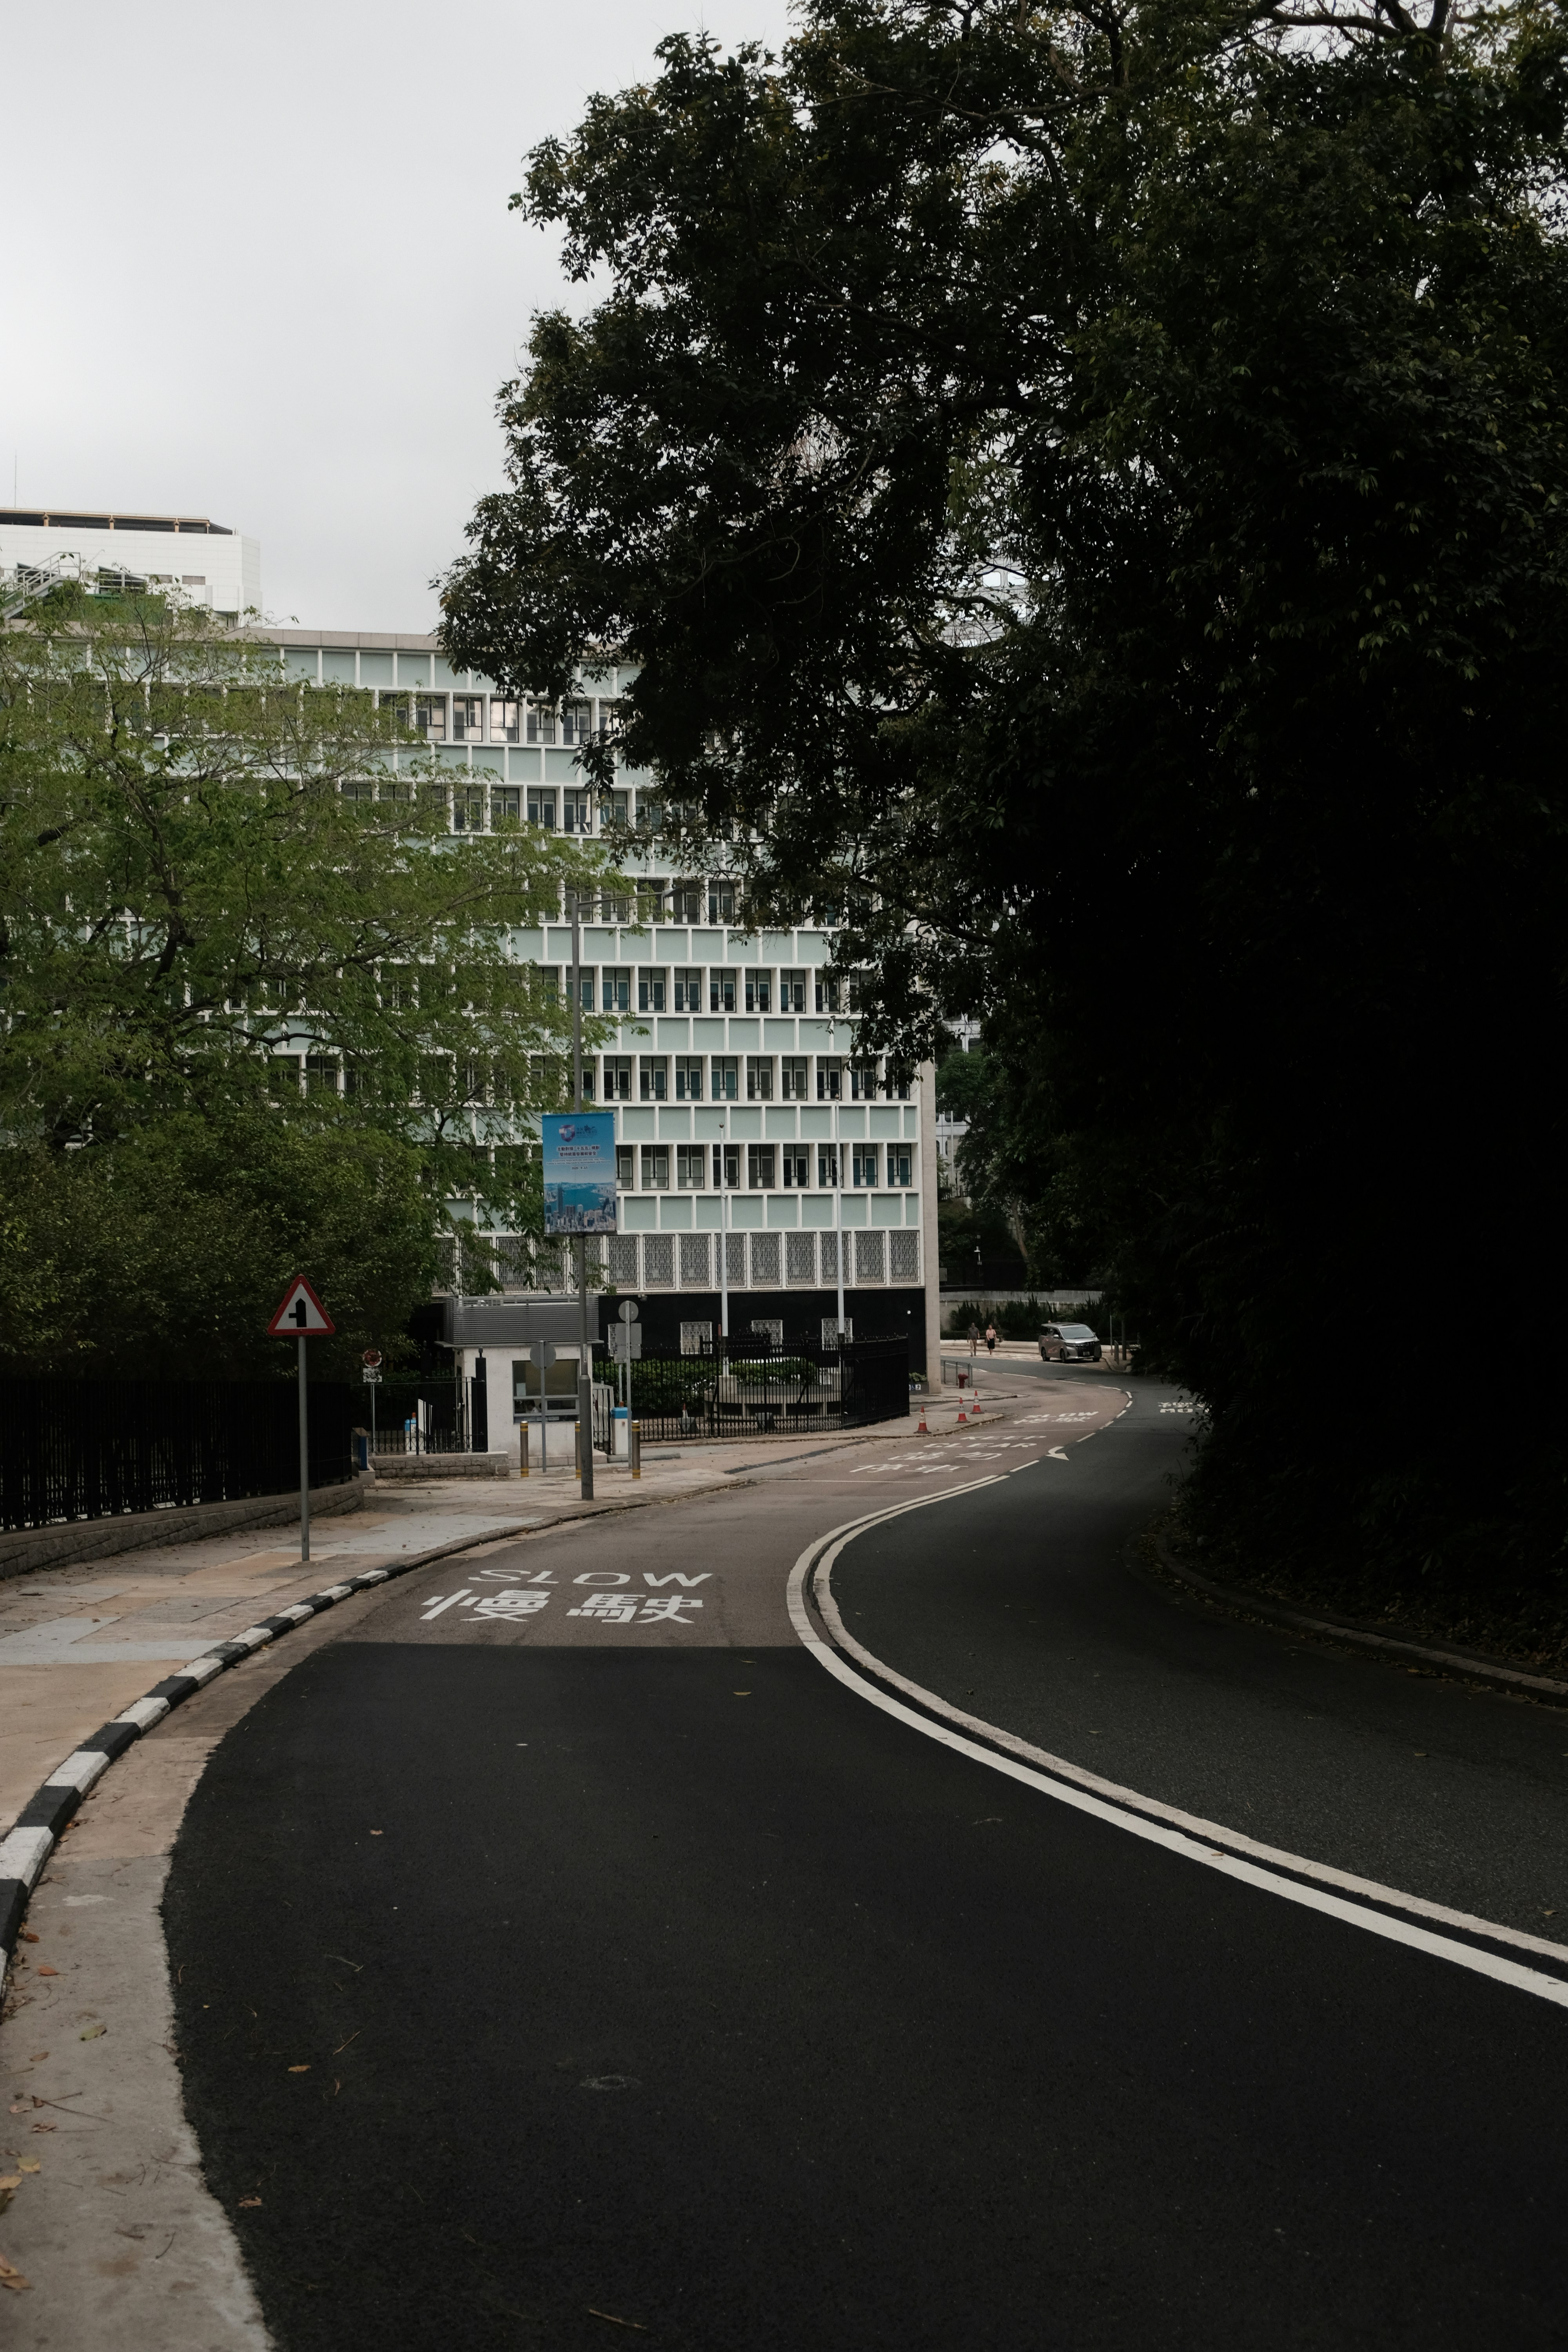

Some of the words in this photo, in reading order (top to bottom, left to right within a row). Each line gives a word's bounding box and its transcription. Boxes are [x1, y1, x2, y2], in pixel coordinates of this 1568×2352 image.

[887, 1452, 1002, 1460] 請勿
[849, 1464, 969, 1473] 停車
[468, 1569, 713, 1587] SLOW
[419, 1589, 704, 1624] 慢駛
